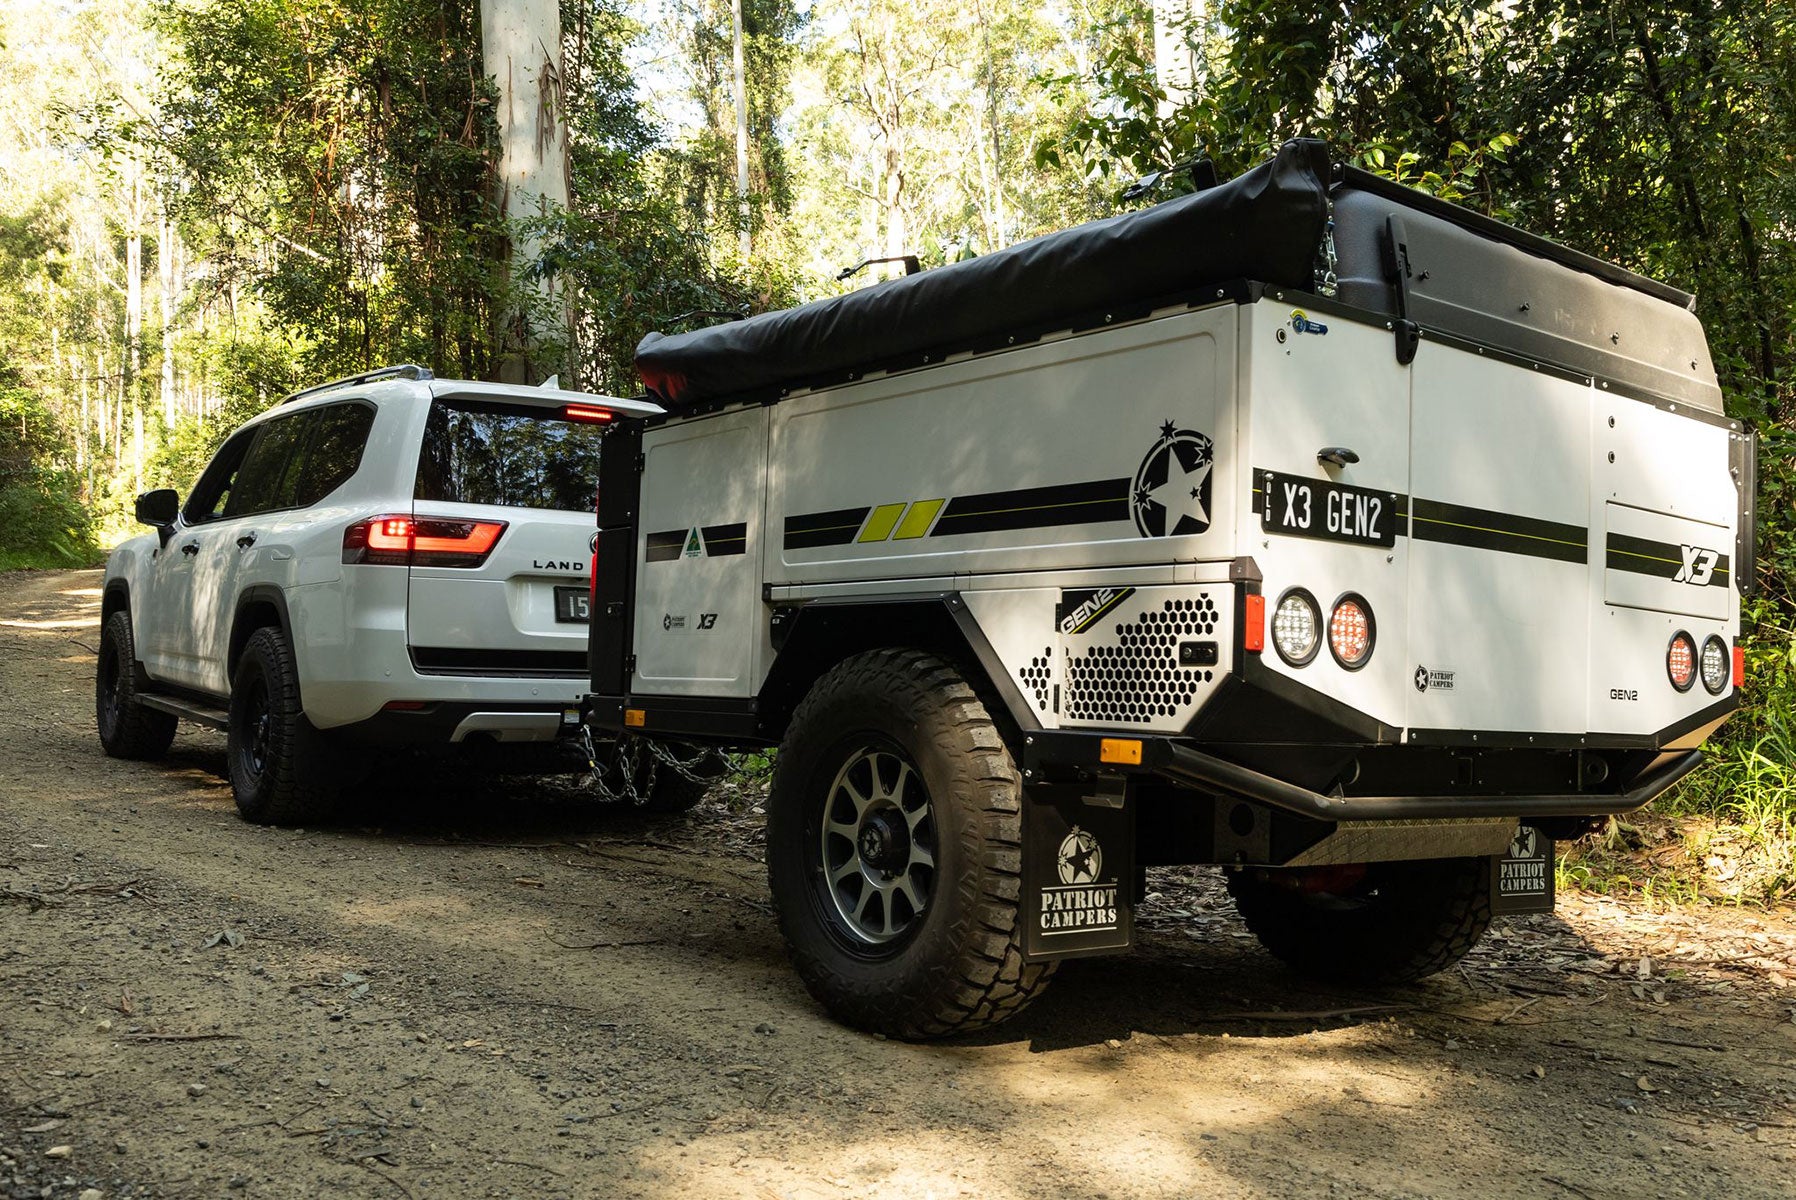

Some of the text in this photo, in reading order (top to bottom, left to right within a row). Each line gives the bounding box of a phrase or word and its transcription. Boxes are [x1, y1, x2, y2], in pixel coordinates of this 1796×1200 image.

[1282, 482, 1382, 539] X3 GEN2
[533, 560, 584, 571] LAND
[1671, 543, 1719, 586] X3
[1061, 588, 1115, 635] GEN2
[696, 613, 718, 630] X3
[1429, 672, 1454, 681] PATRIOT
[1429, 680, 1454, 688] CAMPERS
[1610, 688, 1638, 701] GEN2
[1500, 863, 1545, 878] PATRIOT
[1500, 878, 1545, 891] CAMPERS
[1041, 889, 1117, 911] PATRIOT
[1040, 908, 1117, 929] CAMPERS
